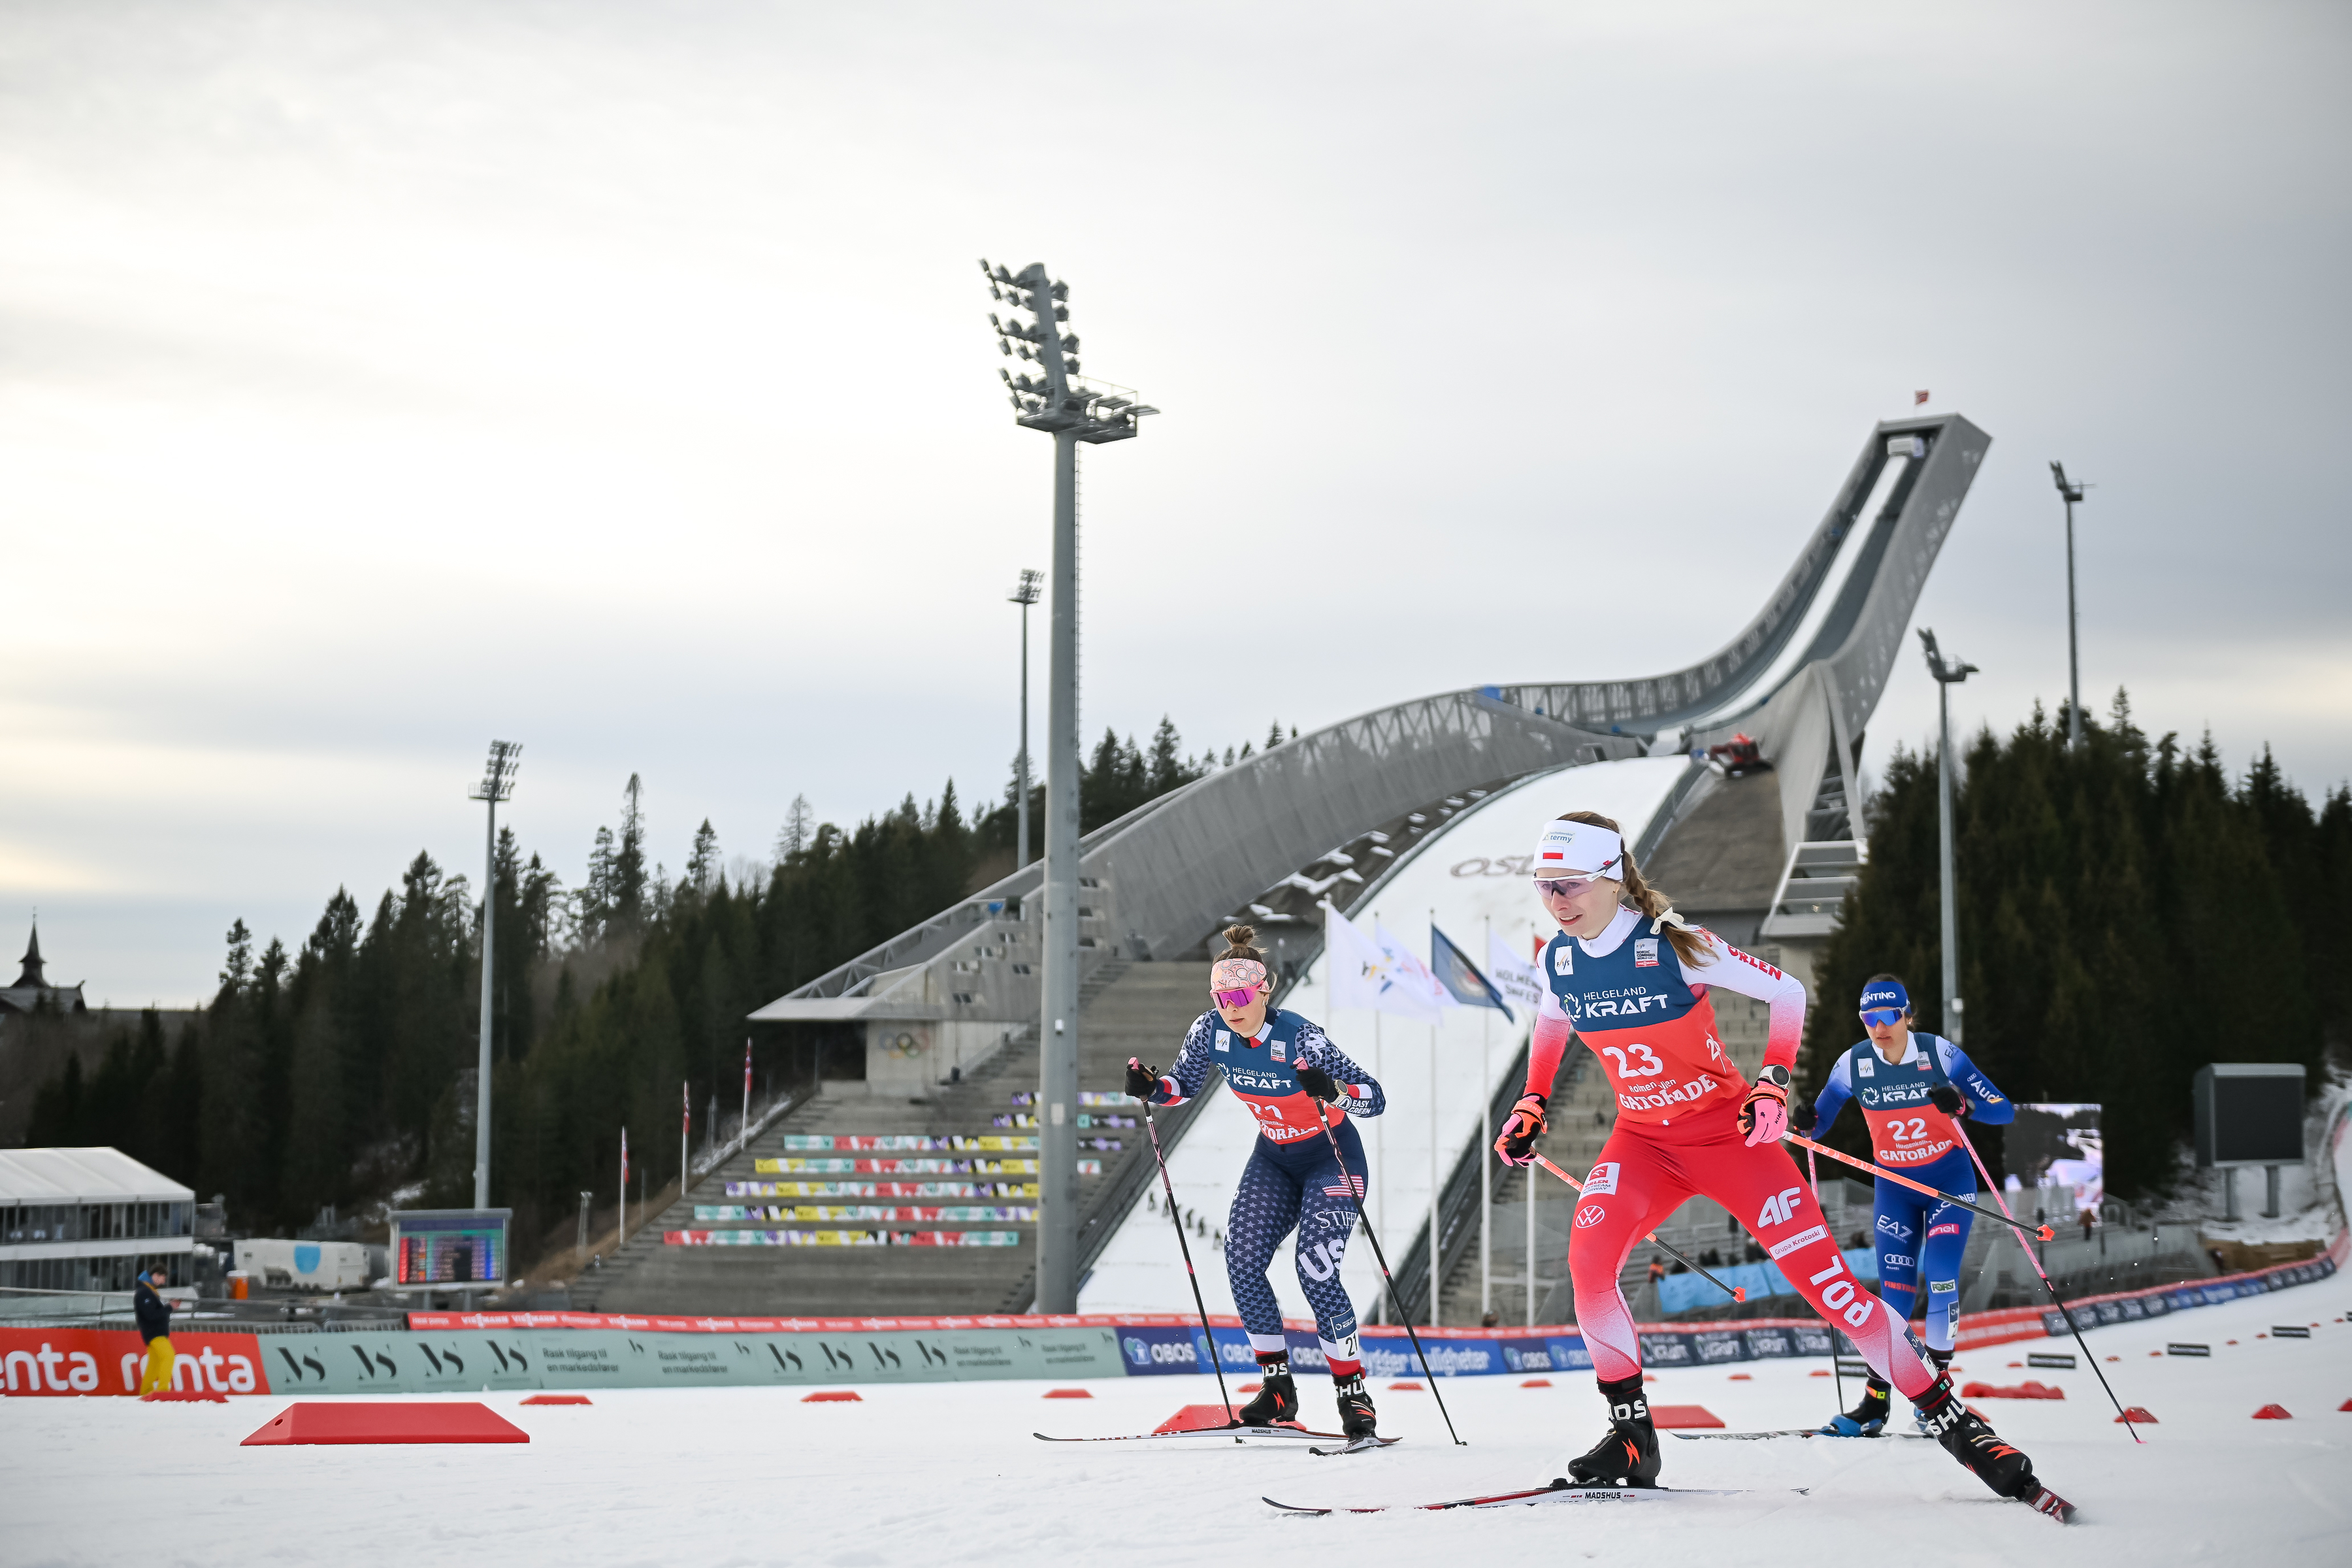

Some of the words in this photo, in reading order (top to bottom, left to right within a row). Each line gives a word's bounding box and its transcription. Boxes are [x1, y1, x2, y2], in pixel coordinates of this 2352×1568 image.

[1550, 834, 1572, 843] termy
[1727, 945, 1782, 981] ORLEN
[1584, 987, 1646, 1000] HELGELAND
[1585, 994, 1667, 1018] KRAFT
[1602, 1043, 1663, 1079] 23
[1232, 1067, 1277, 1078] HELGELAND
[1233, 1074, 1292, 1089] KRAFT
[1882, 1082, 1925, 1092] HELGELAND
[1882, 1087, 1931, 1103] KRAF
[1970, 1080, 2000, 1101] Aud
[1887, 1117, 1927, 1141] 22
[1757, 1186, 1801, 1228] 4F
[1929, 1224, 1955, 1236] enel
[1774, 1244, 1791, 1255] Grupa
[1792, 1230, 1820, 1246] Krotoski
[1298, 1239, 1348, 1281] US
[1810, 1254, 1874, 1328] POL
[1884, 1280, 1916, 1292] FINSTRA
[1932, 1281, 1955, 1291] FORST
[1151, 1343, 1196, 1363] OBOS
[1346, 1333, 1358, 1357] 21
[542, 1347, 564, 1358] Rask
[566, 1347, 596, 1360] tilgang
[599, 1347, 608, 1358] til
[658, 1350, 678, 1360] Rask
[546, 1364, 558, 1373] en
